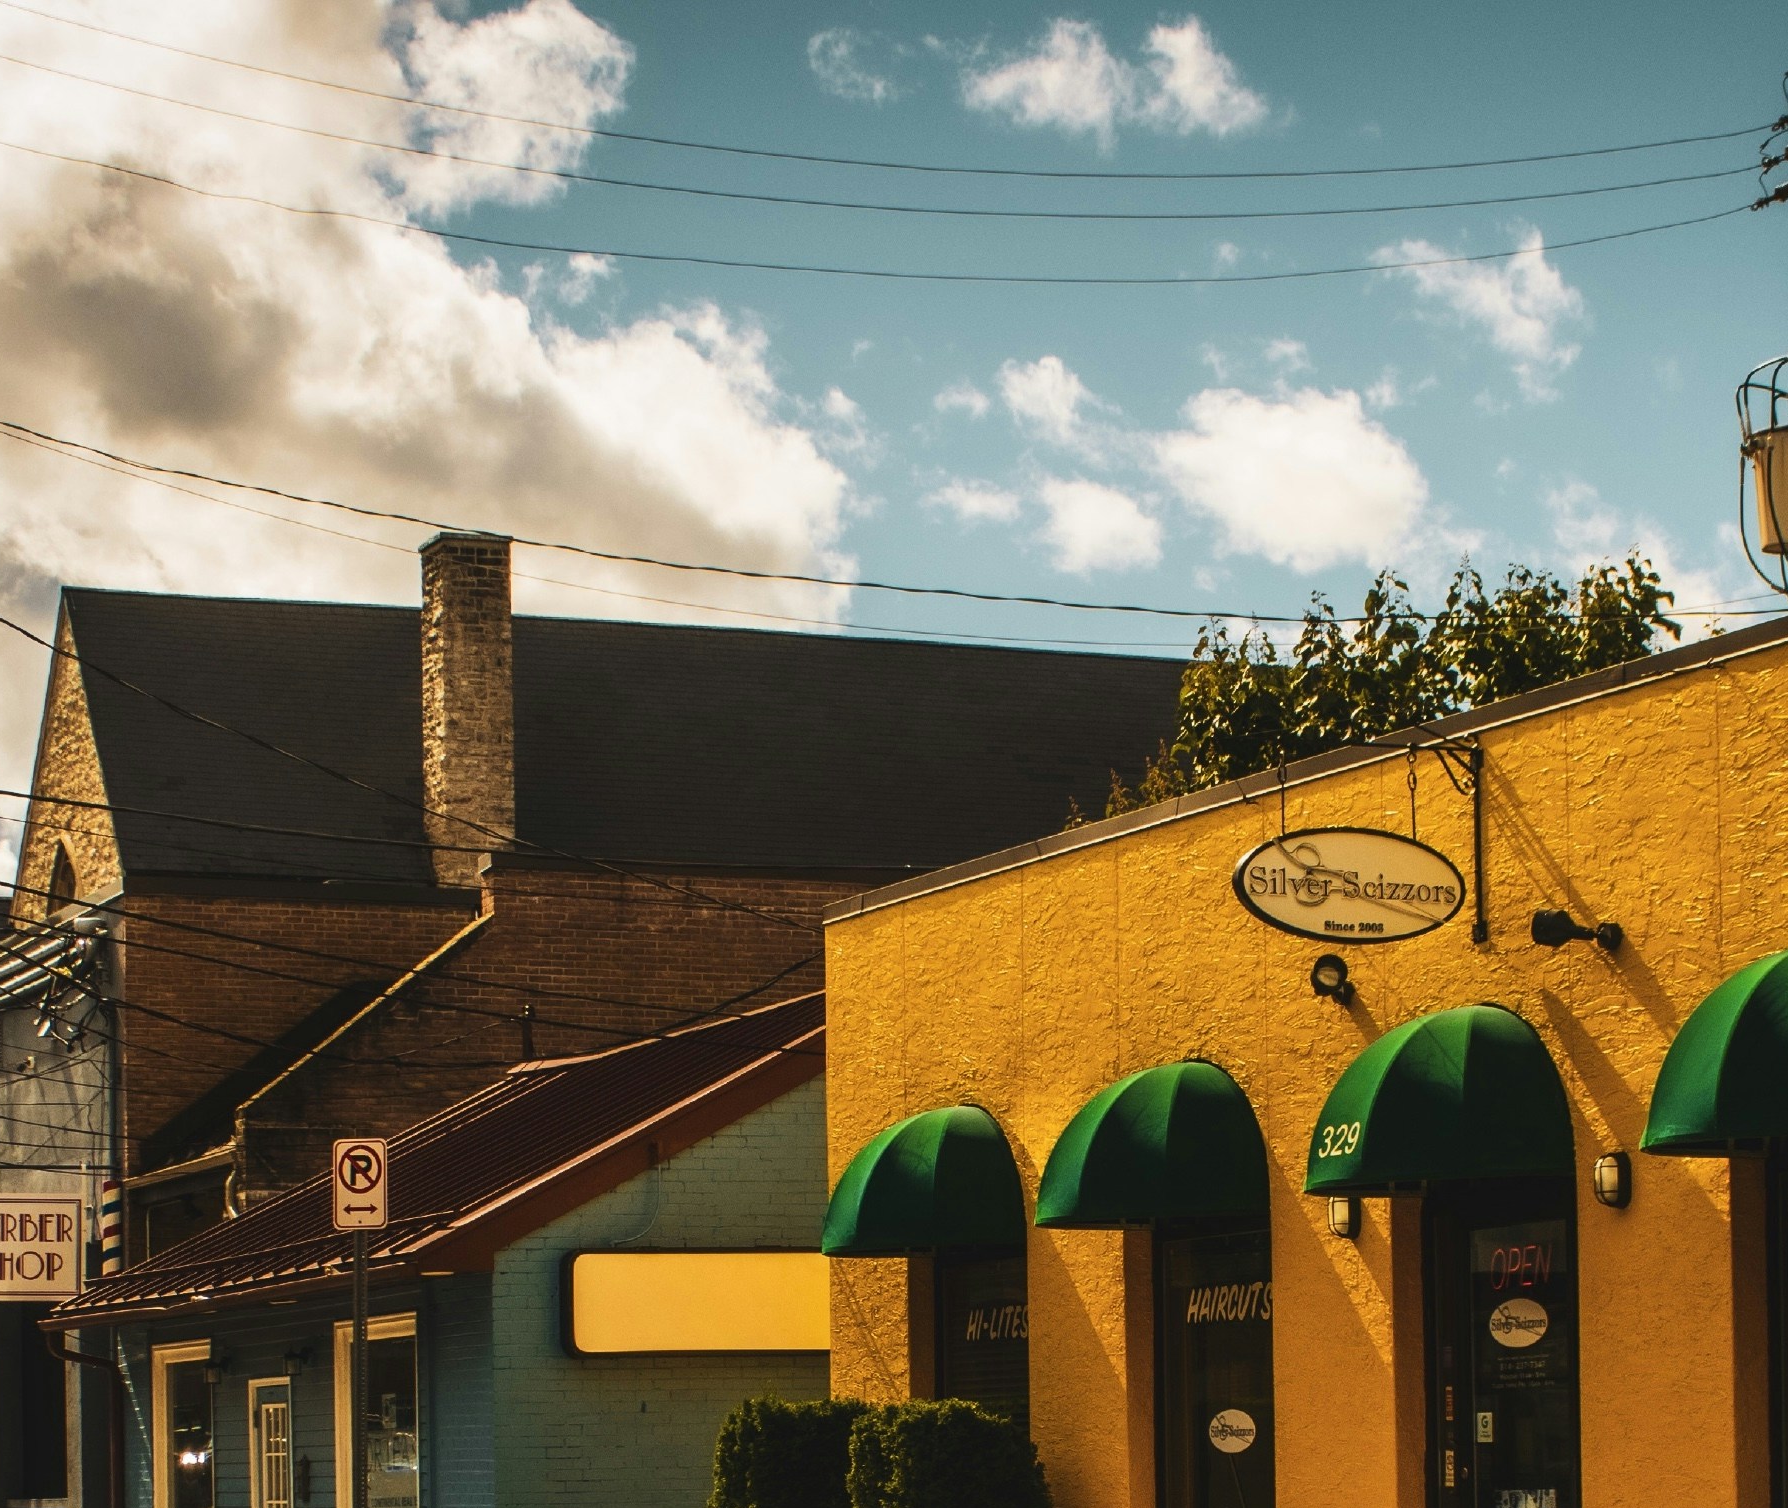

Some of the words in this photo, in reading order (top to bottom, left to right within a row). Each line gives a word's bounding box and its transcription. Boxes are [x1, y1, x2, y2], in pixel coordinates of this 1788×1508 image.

[1249, 866, 1332, 897] Silver
[1341, 871, 1457, 904] Scizzors
[1323, 920, 1356, 932] Since
[1318, 1121, 1361, 1158] 329
[350, 1154, 373, 1186] P
[1490, 1244, 1553, 1290] OPEN
[1187, 1281, 1273, 1324] HAIRCUTS
[966, 1304, 1029, 1341] HI-LITES
